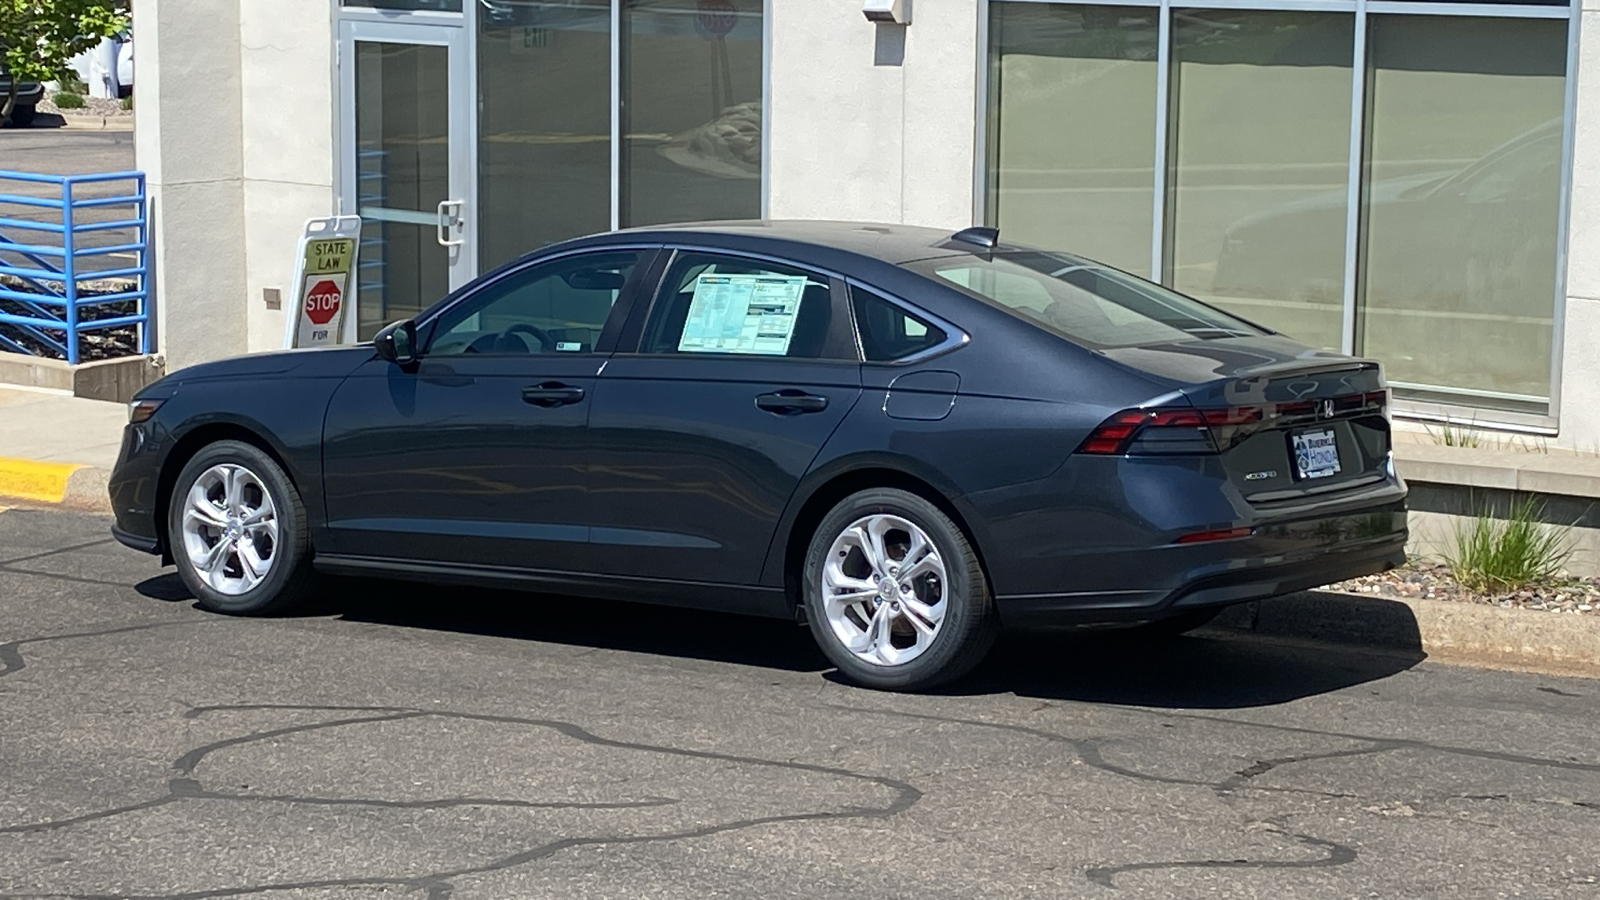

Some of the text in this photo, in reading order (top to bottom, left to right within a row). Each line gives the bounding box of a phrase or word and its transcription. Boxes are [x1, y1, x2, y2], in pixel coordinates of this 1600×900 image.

[523, 27, 548, 48] EXIT
[315, 242, 347, 256] STATE
[317, 257, 341, 270] LAW
[306, 293, 340, 311] STOP
[312, 329, 329, 341] FOR
[1310, 449, 1338, 466] HONDA
